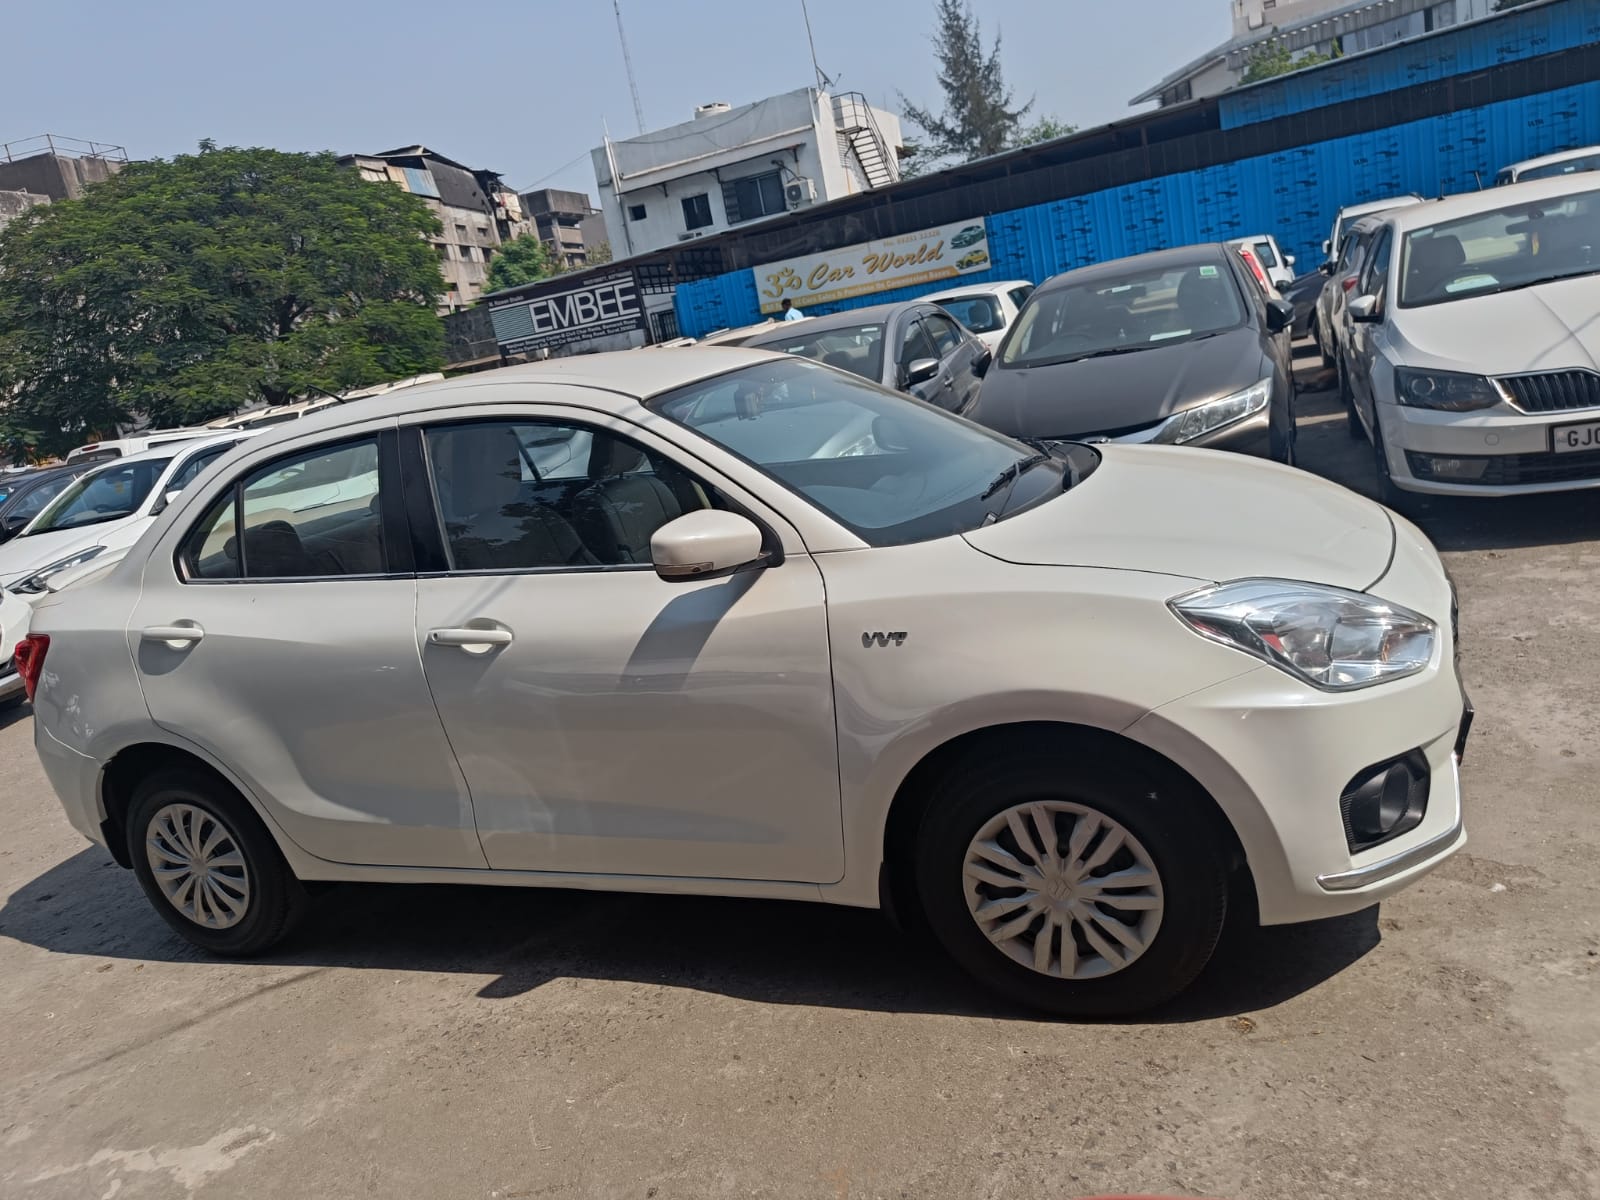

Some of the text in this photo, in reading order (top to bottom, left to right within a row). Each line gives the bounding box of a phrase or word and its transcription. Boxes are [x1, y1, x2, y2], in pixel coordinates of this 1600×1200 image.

[807, 240, 945, 290] Car World
[529, 281, 641, 333] EMBEE
[861, 631, 908, 648] VVT
